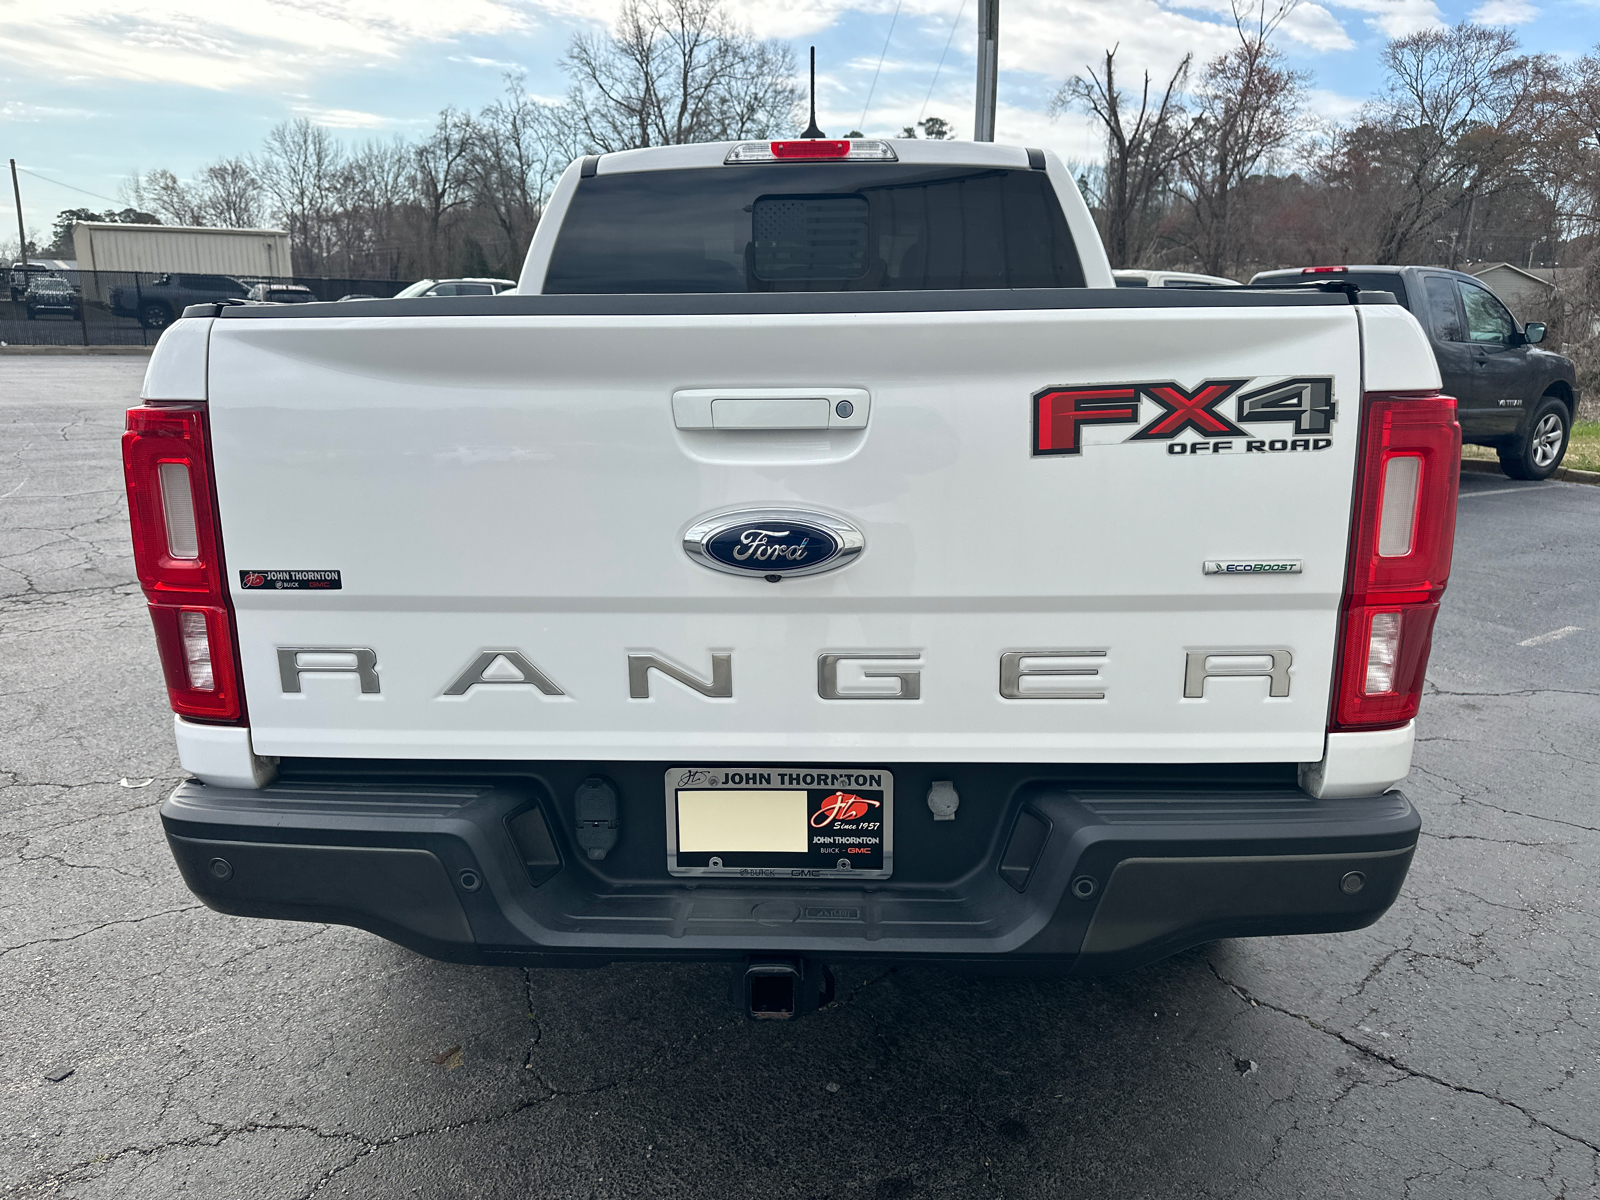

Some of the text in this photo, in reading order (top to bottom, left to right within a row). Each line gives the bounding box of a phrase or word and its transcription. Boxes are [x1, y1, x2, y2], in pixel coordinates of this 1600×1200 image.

[1032, 376, 1336, 456] FX4
[1168, 438, 1332, 455] OFF ROAD
[733, 529, 809, 561] Ford
[267, 571, 338, 580] JOHN THORNTON
[276, 645, 1294, 700] RANGER
[722, 773, 882, 788] JOHN THORNTON
[833, 822, 880, 831] Since 1957
[812, 836, 880, 845] JOHN THORNTON
[750, 869, 775, 877] BUICK
